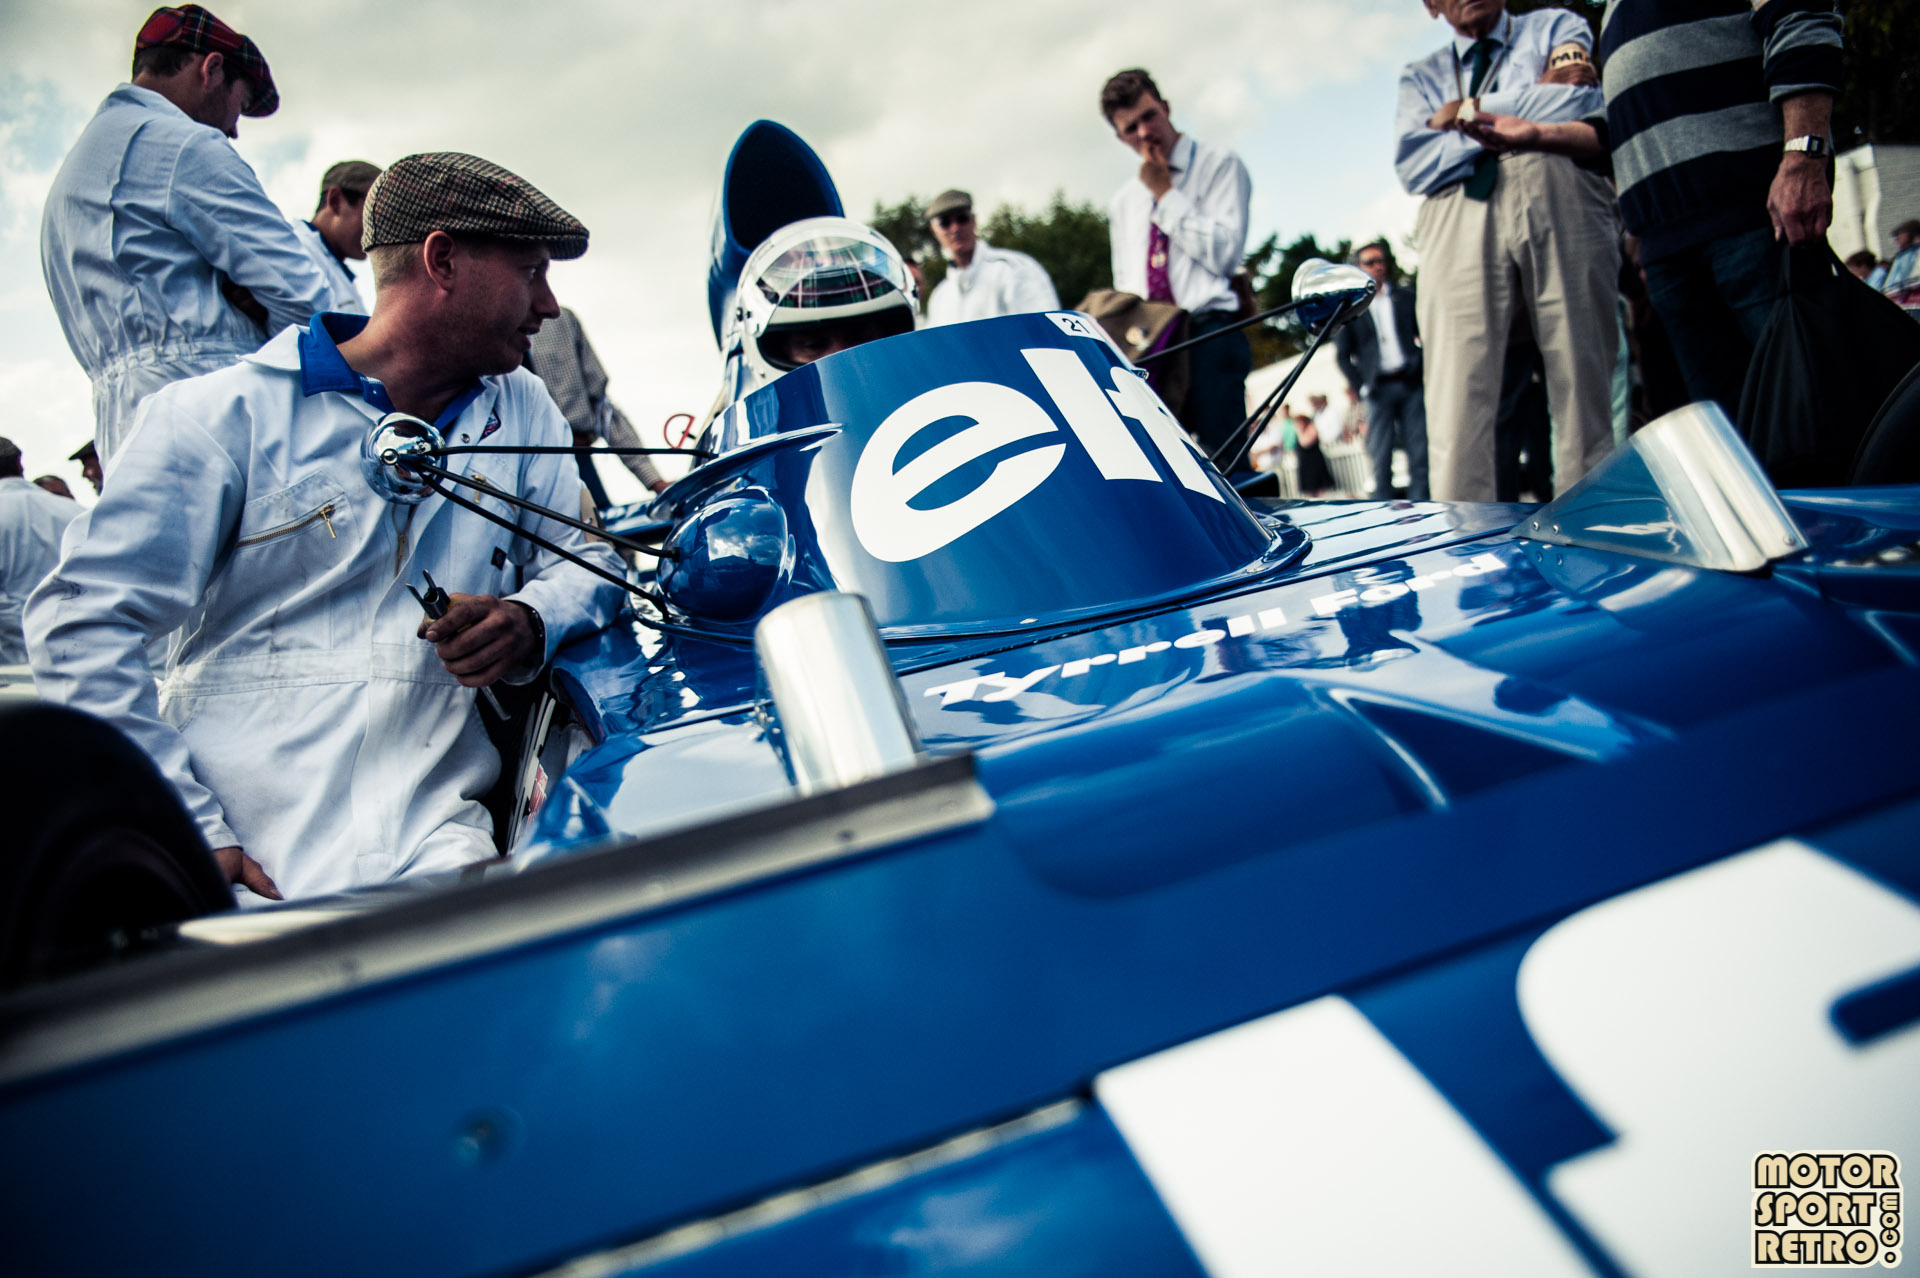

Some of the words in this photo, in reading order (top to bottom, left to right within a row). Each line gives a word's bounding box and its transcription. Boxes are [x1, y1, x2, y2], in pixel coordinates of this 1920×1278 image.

[1061, 317, 1090, 334] 21
[850, 346, 1226, 563] elf
[1310, 552, 1506, 616] Ford
